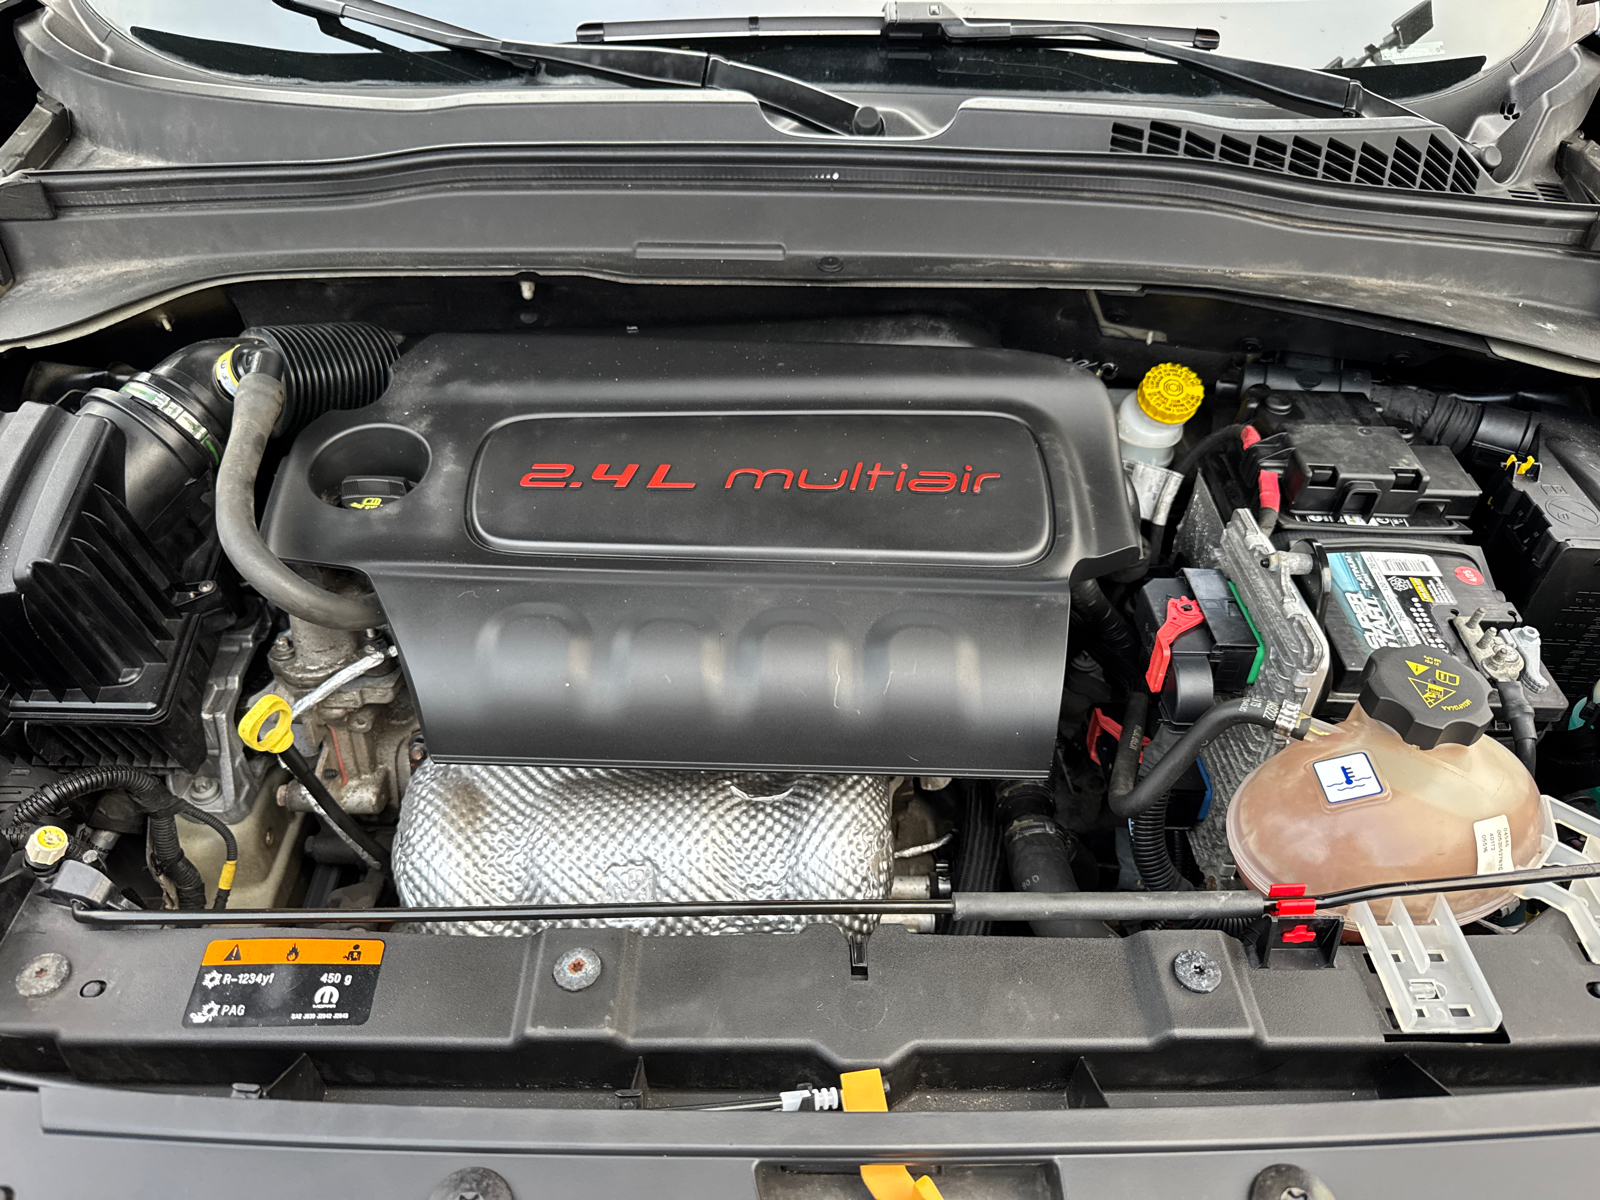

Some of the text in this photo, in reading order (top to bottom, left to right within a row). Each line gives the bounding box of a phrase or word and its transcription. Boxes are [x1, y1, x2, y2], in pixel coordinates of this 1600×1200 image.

[724, 461, 1002, 494] multiair
[1345, 556, 1369, 590] PLATINUM
[1345, 592, 1381, 649] SUPER
[320, 972, 353, 986] 450 g
[220, 1004, 246, 1016] PAG
